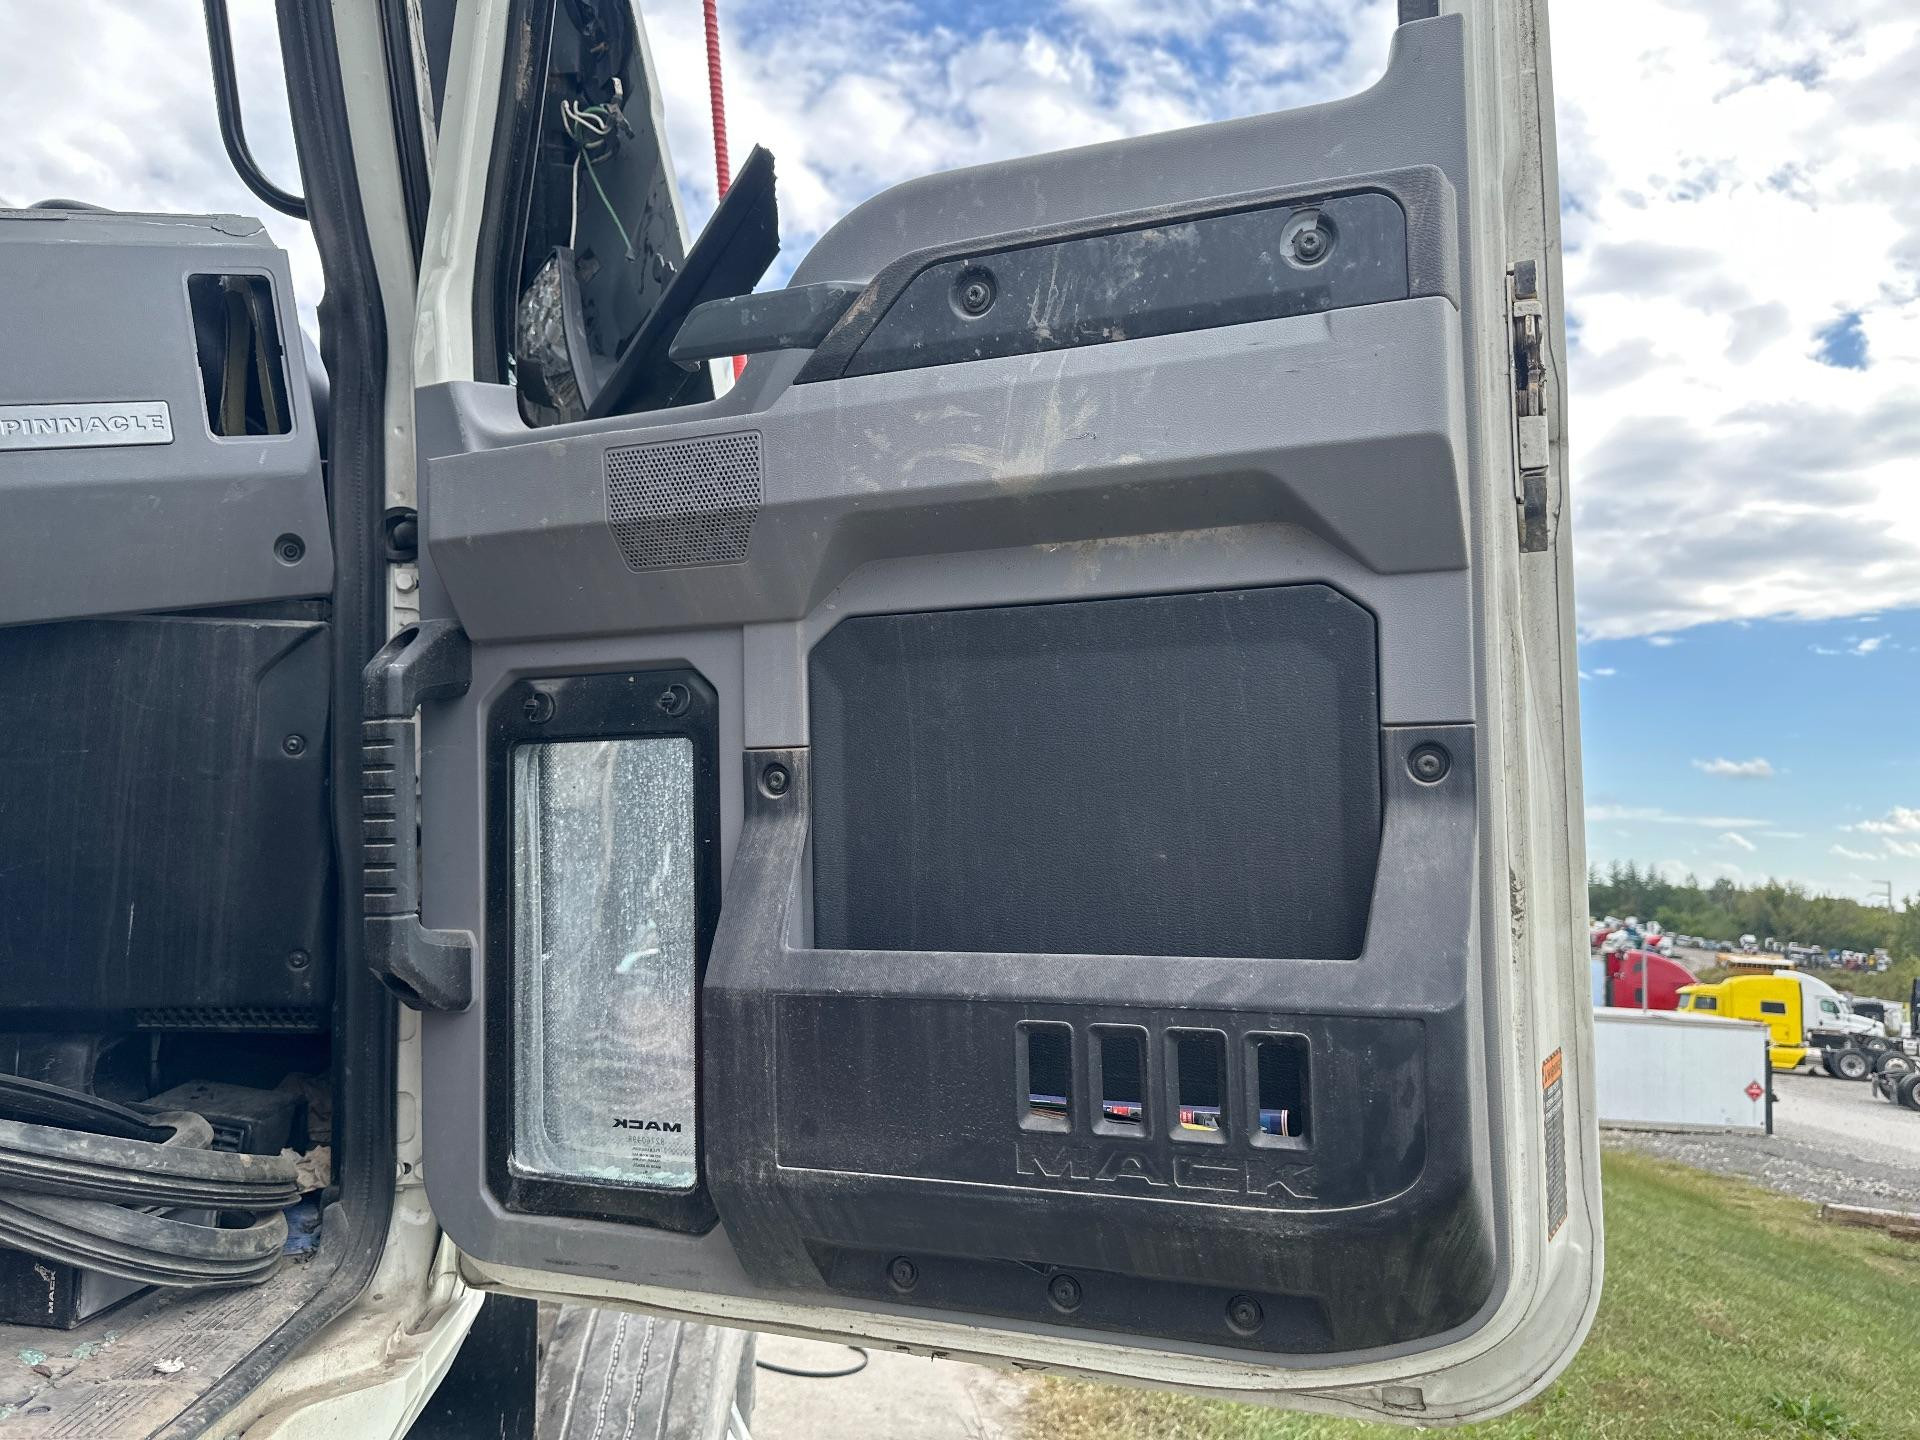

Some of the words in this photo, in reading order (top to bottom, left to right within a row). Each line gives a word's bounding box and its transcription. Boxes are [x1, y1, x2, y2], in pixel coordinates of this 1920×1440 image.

[0, 415, 165, 436] PINNACLE
[1015, 1146, 1318, 1199] MACK
[48, 1271, 56, 1313] MACK
